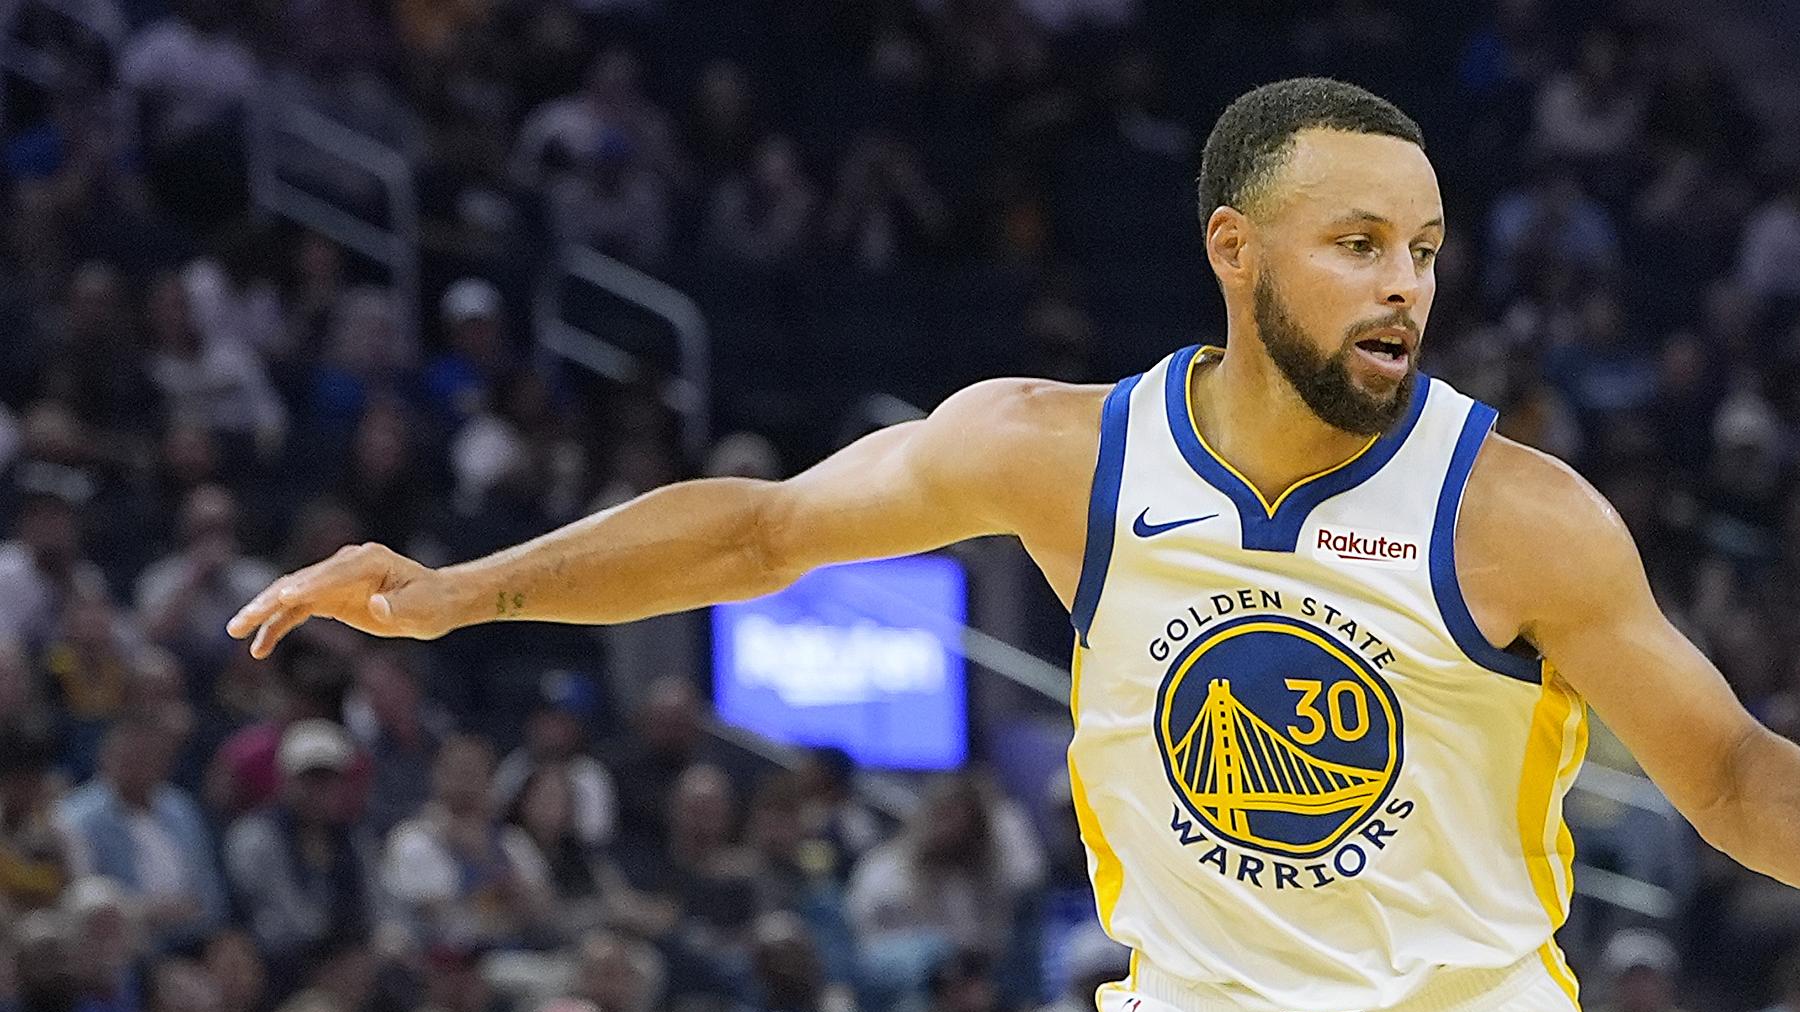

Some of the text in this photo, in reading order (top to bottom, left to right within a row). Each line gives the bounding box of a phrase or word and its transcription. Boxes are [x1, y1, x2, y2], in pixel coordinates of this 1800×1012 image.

[1317, 529, 1417, 560] Rakuten
[1150, 590, 1396, 669] GOLDEN STATE
[1284, 678, 1370, 745] 30
[1171, 798, 1414, 889] WARRIORS
